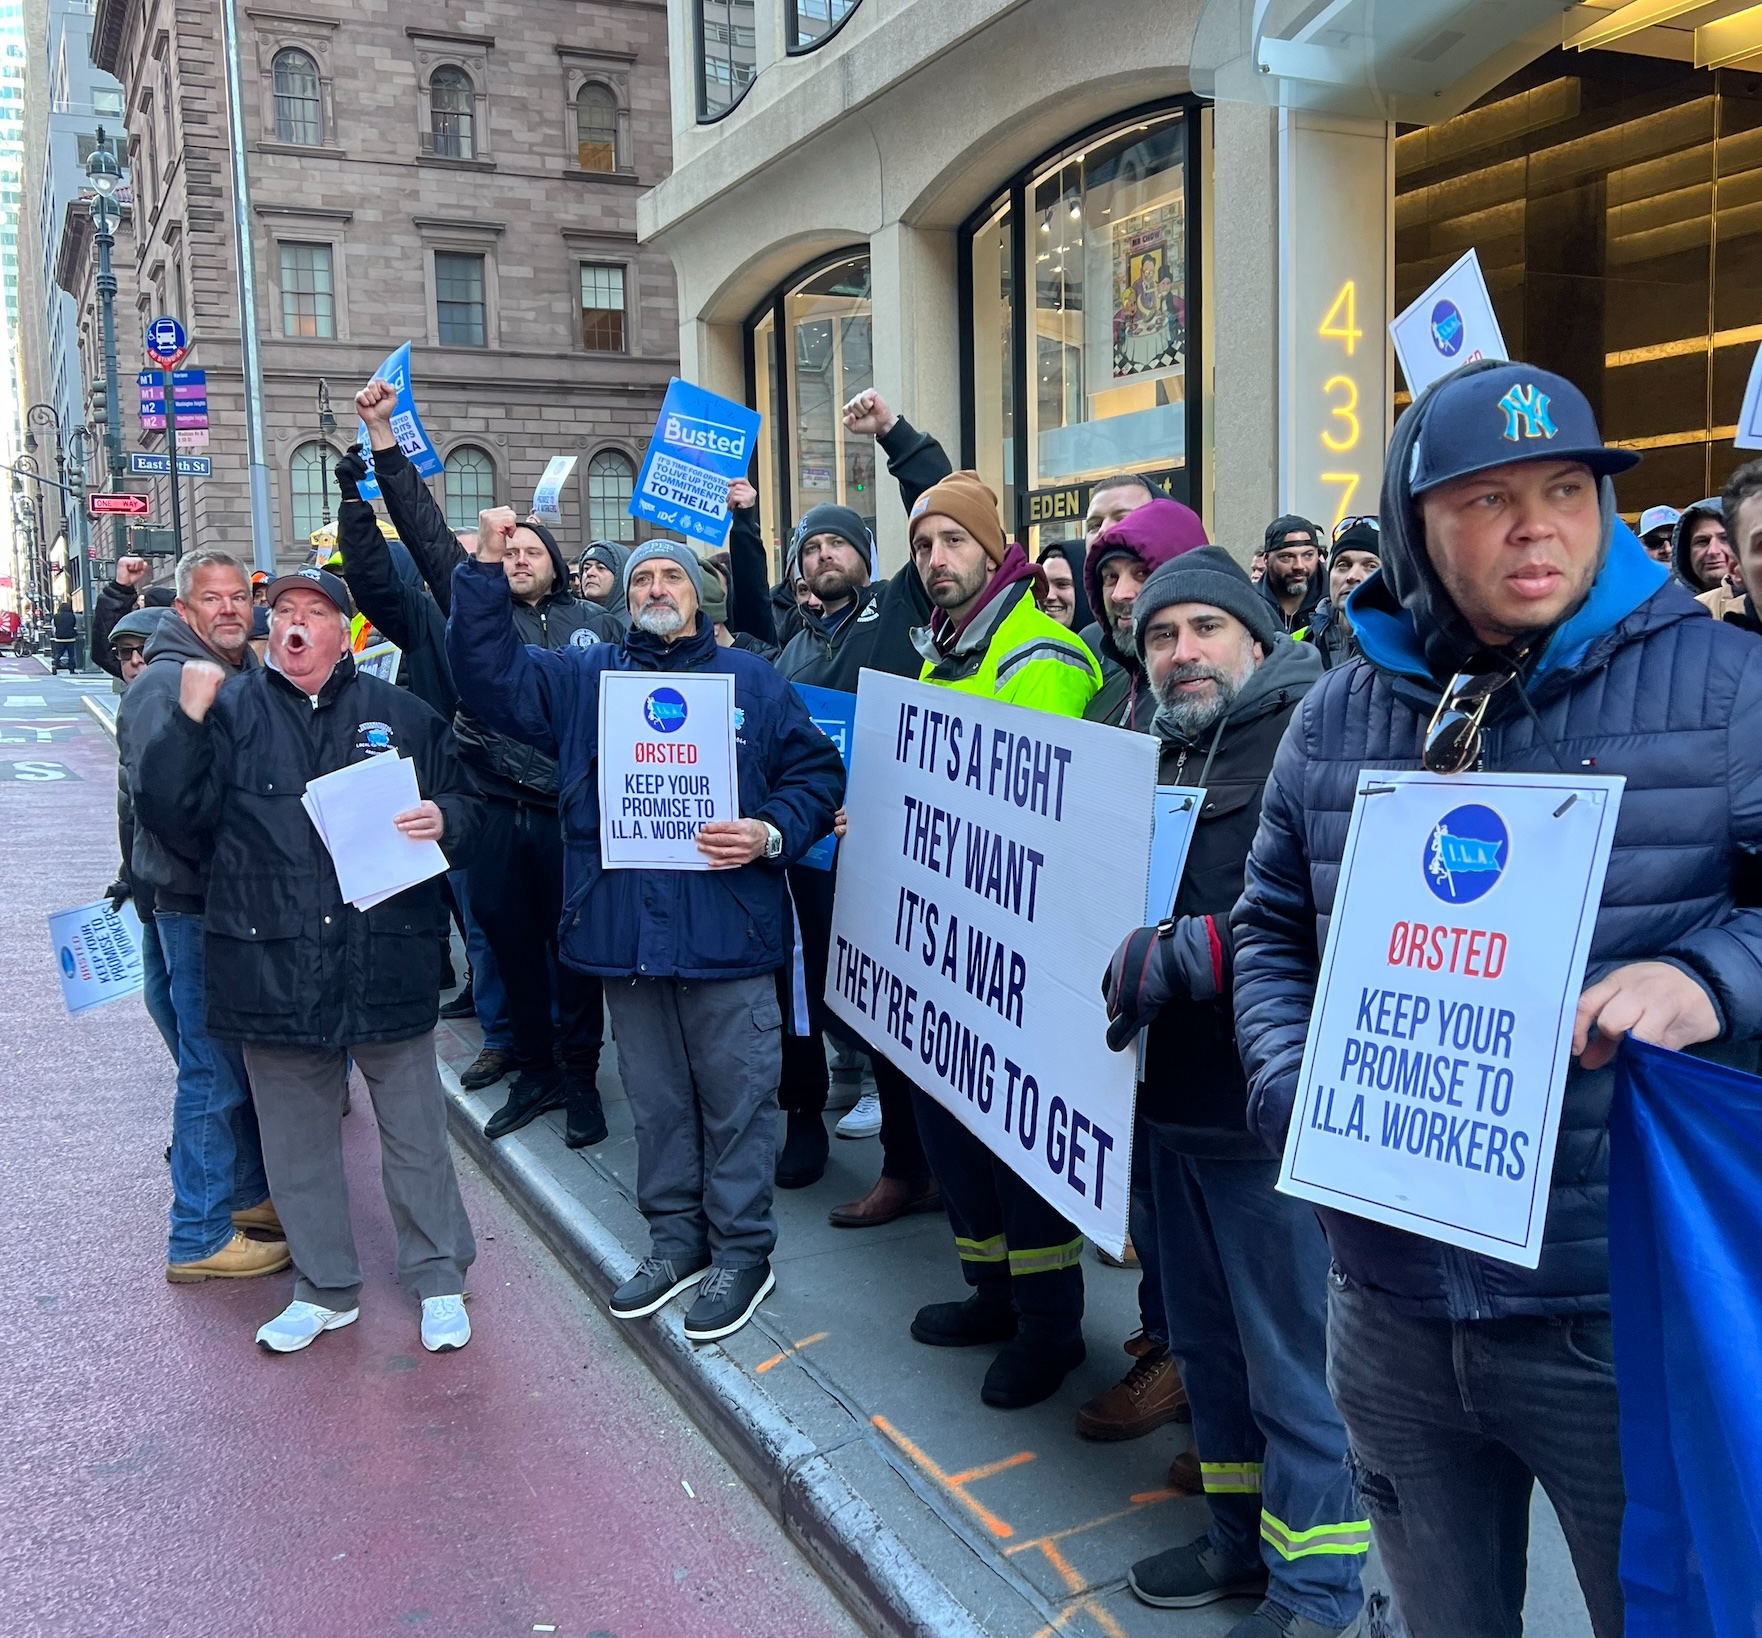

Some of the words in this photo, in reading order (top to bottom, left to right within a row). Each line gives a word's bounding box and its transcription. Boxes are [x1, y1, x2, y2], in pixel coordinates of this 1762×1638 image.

[140, 374, 153, 384] M1
[141, 388, 154, 398] M1
[142, 402, 156, 413] M2
[143, 416, 157, 427] M2
[1498, 384, 1558, 441] NY
[401, 422, 412, 430] ITS
[664, 417, 745, 456] Busted
[138, 458, 162, 470] East
[166, 461, 190, 471] 5th
[193, 462, 205, 472] St
[656, 463, 668, 473] TO
[669, 468, 687, 480] LIVE
[688, 475, 701, 484] UP
[702, 480, 714, 489] TO
[713, 485, 728, 495] ITS
[658, 456, 671, 466] IT'S
[671, 461, 688, 472] TIME
[689, 467, 703, 477] FOR
[651, 481, 669, 496] TO
[671, 488, 698, 507] THE
[698, 499, 720, 516] ILA
[653, 471, 725, 503] COMMITMENTS
[1030, 490, 1079, 520] EDEN
[634, 741, 698, 765] ØRSTED
[896, 702, 918, 763] IF
[918, 709, 964, 782] IT'S
[965, 723, 982, 791] A
[988, 728, 1072, 823] FIGHT
[625, 774, 665, 794] KEEP
[667, 775, 710, 795] YOUR
[622, 797, 692, 818] PROMISE
[694, 798, 715, 818] TO
[611, 819, 648, 840] I.L.A.
[650, 820, 715, 840] WORK
[902, 794, 961, 879] THEY
[964, 821, 1045, 923] WANT
[1448, 843, 1494, 865] I.L.A.
[81, 924, 99, 955] YOUR
[91, 917, 106, 933] TO
[101, 906, 137, 959] WORKERS
[97, 932, 128, 982] PROMISE
[895, 886, 939, 967] IT'S
[941, 914, 958, 984] A
[965, 924, 1027, 1029] WAR
[1386, 919, 1508, 979] ØRSTED
[92, 955, 111, 984] KEEP
[1355, 987, 1431, 1041] KEEP
[1438, 999, 1516, 1059] YOUR
[835, 934, 918, 1051] THEY'RE
[919, 999, 996, 1114] GOING
[1003, 1057, 1040, 1151] TO
[1045, 1095, 1114, 1212] GET
[1339, 1037, 1469, 1108] PROMISE
[1475, 1062, 1514, 1117] TO
[1311, 1085, 1370, 1143] I.L.A.
[1380, 1100, 1530, 1182] WORKERS
